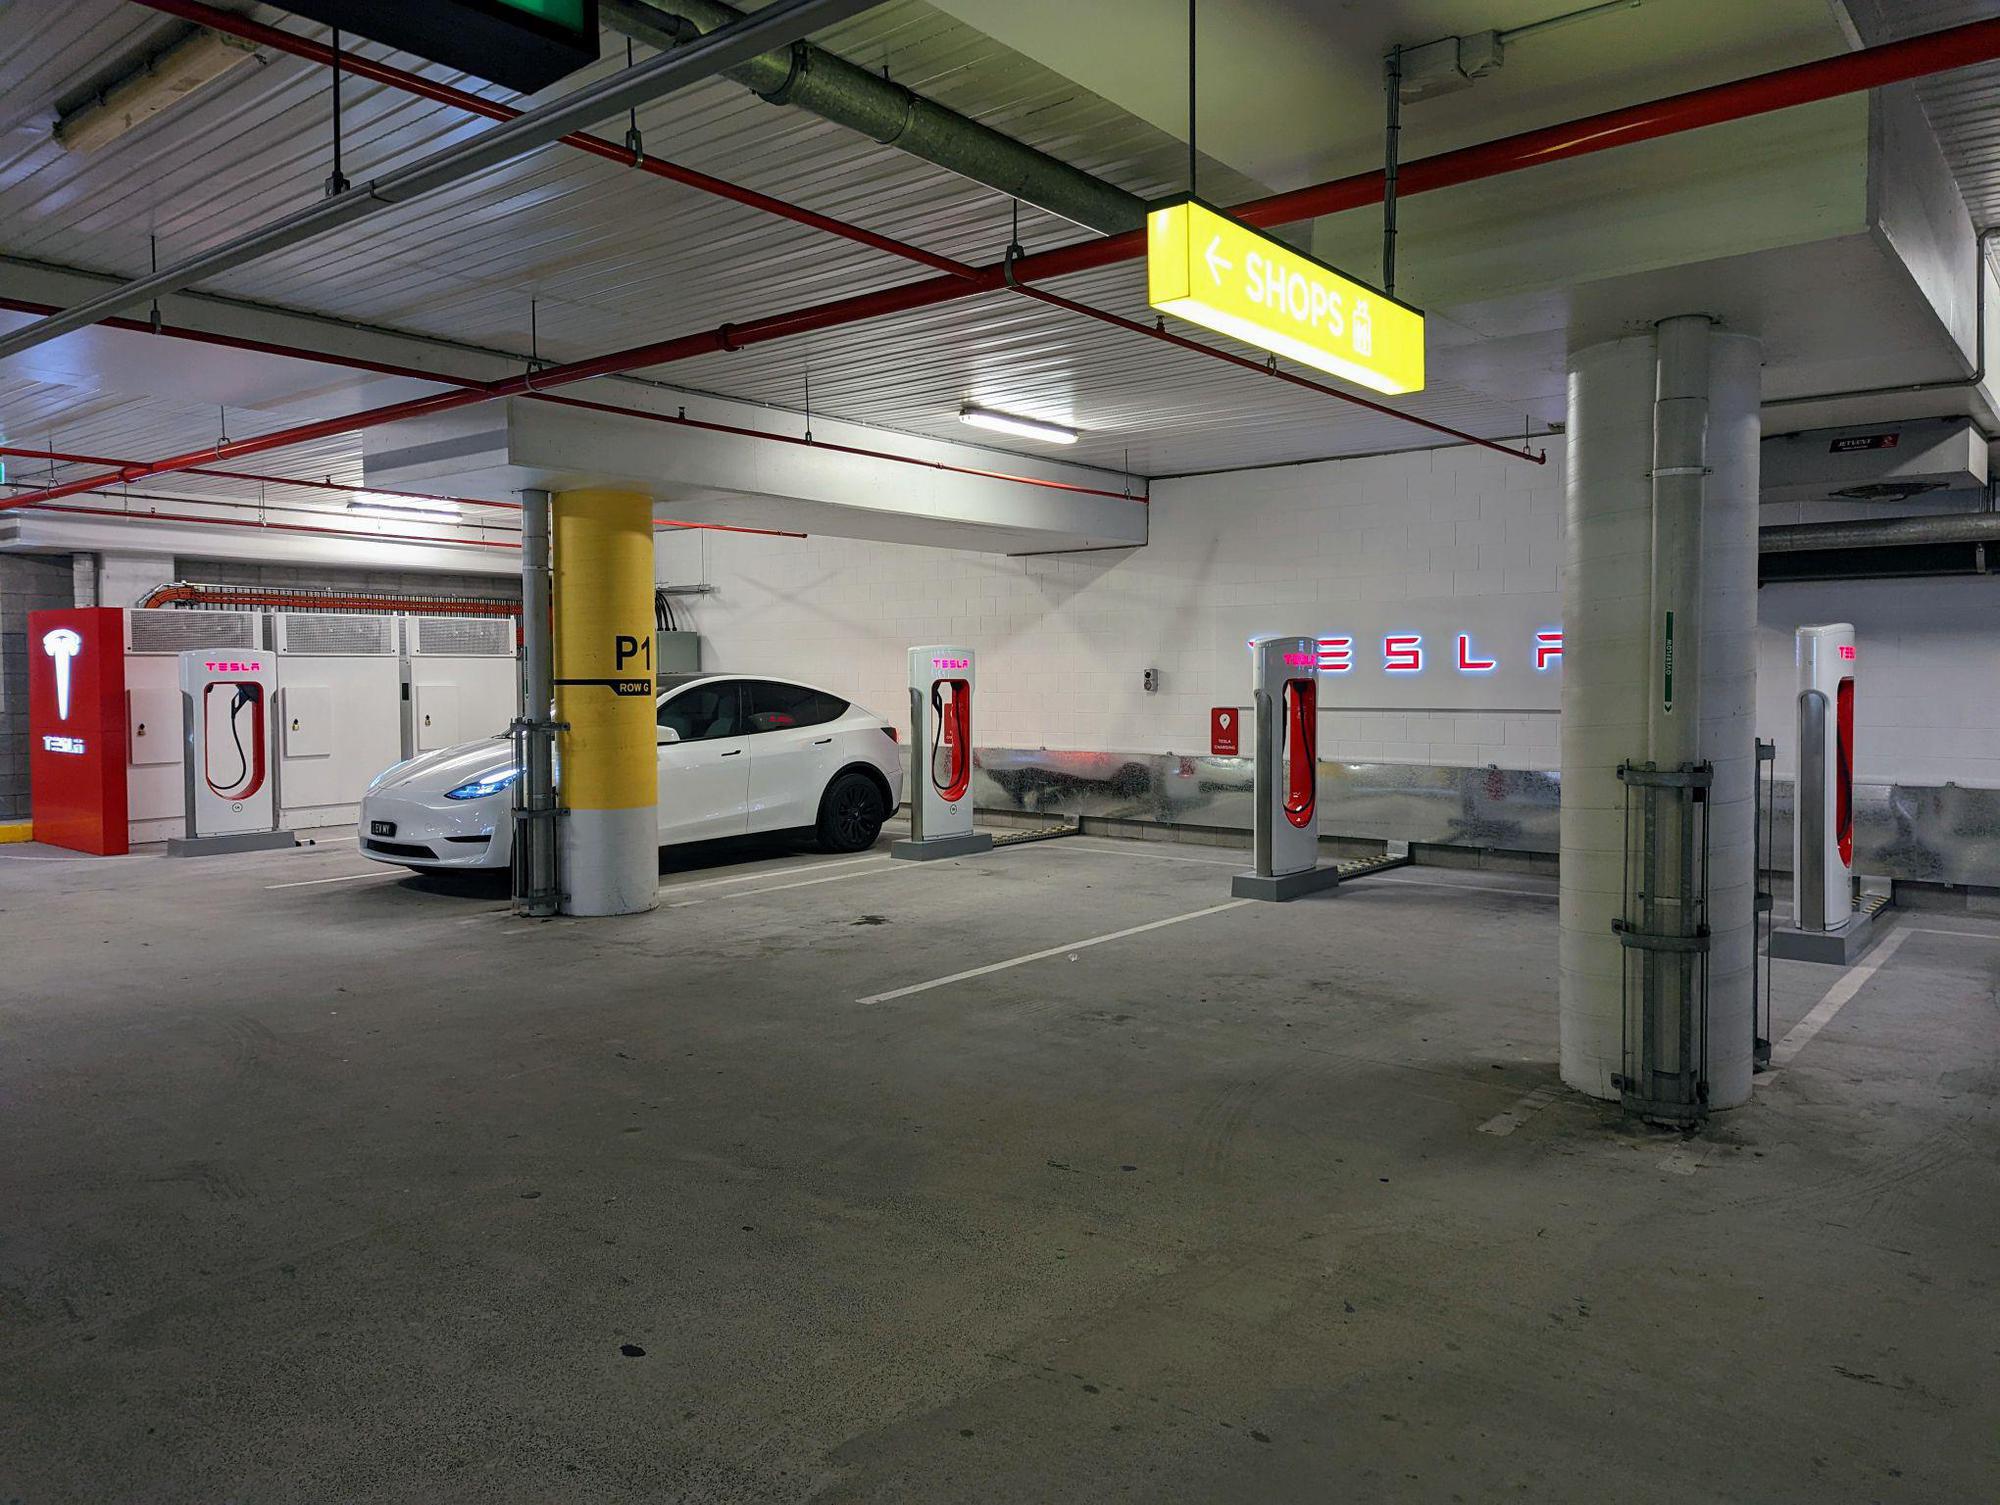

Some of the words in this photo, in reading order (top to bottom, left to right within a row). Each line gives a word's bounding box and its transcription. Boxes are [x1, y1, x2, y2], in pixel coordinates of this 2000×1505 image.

[1245, 251, 1345, 337] SHOPS
[205, 662, 260, 672] TESLA
[615, 635, 650, 670] P1
[932, 659, 969, 669] TESLA
[1247, 633, 1563, 671] ESLA
[1665, 638, 1673, 676] OVERFLOW
[619, 683, 641, 692] ROW
[643, 683, 649, 692] G
